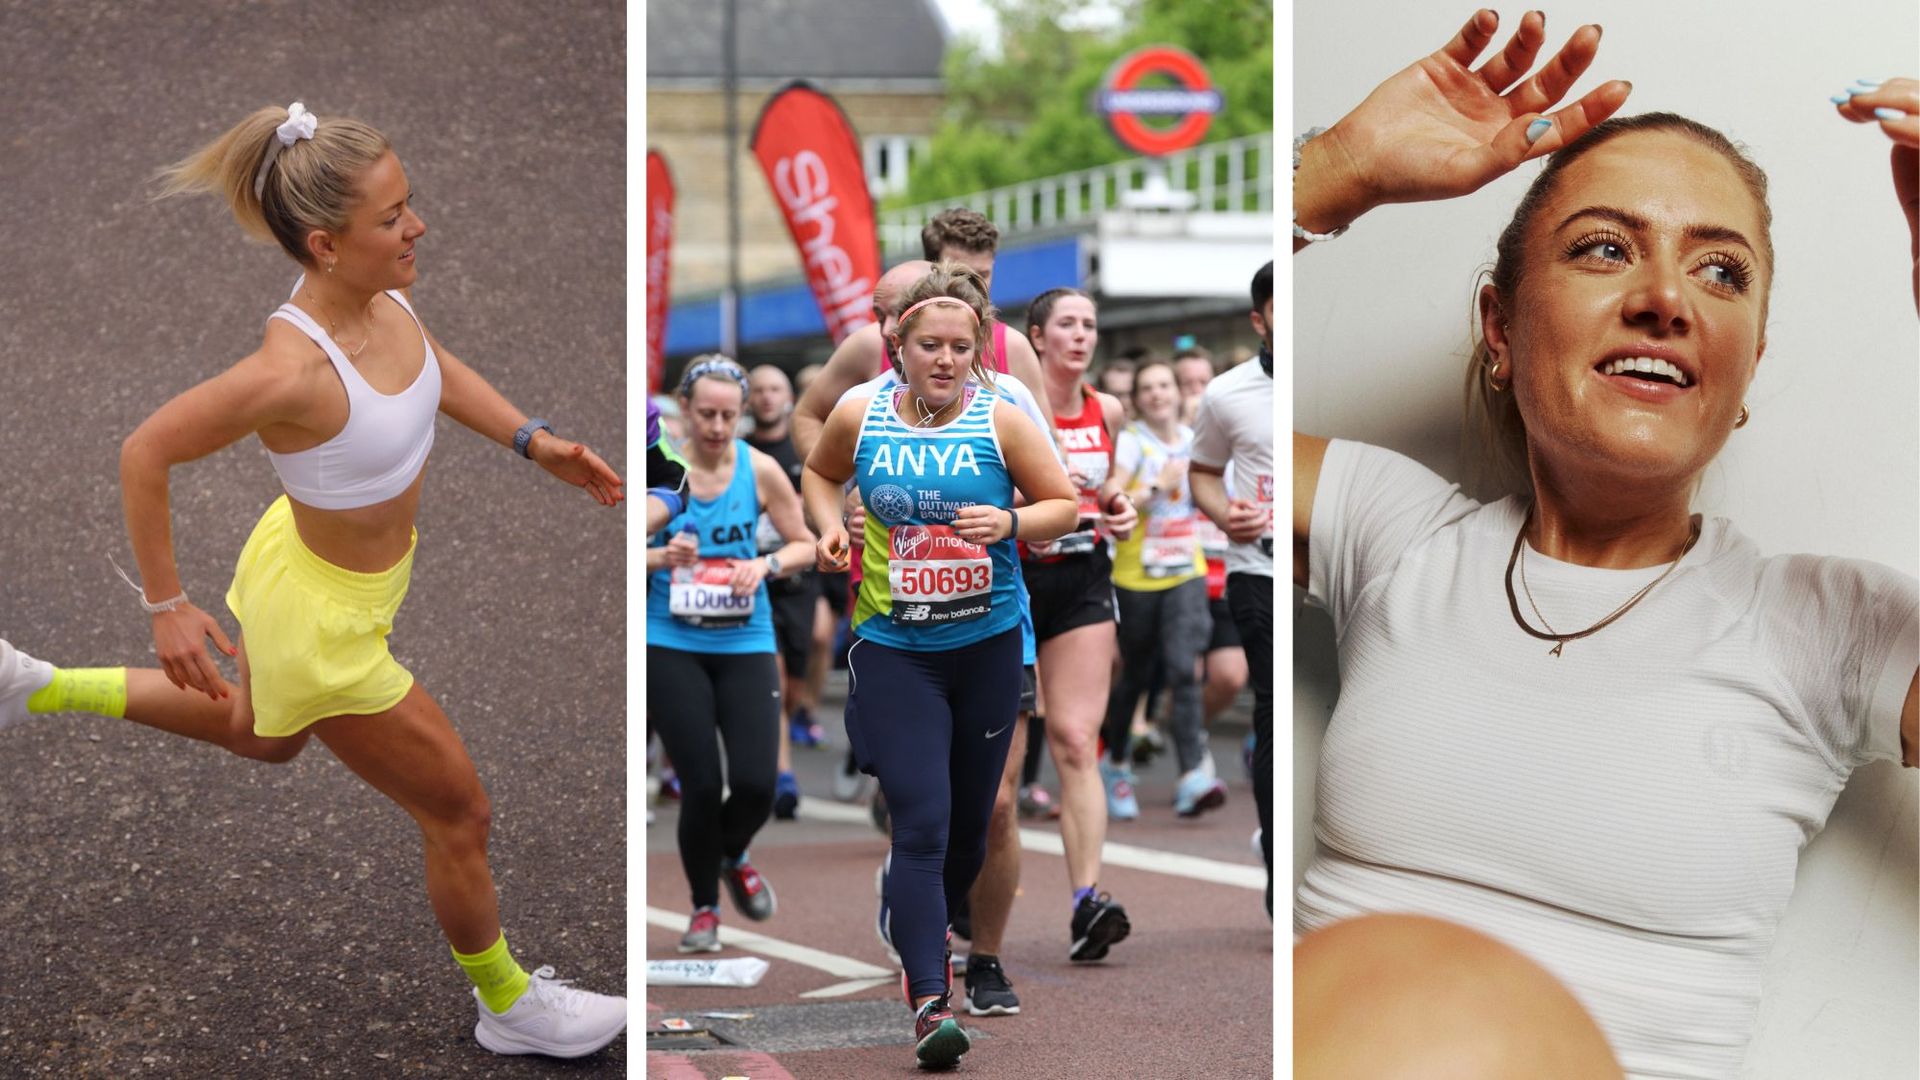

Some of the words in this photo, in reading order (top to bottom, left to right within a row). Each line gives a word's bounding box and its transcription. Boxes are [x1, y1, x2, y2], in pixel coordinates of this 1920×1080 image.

[1056, 425, 1102, 449] CKY
[868, 444, 981, 476] ANYA
[917, 490, 941, 500] THE
[711, 521, 753, 545] CAT
[895, 526, 930, 558] Virgin
[901, 564, 990, 595] 50693
[931, 612, 950, 620] new
[950, 606, 985, 618] balance
